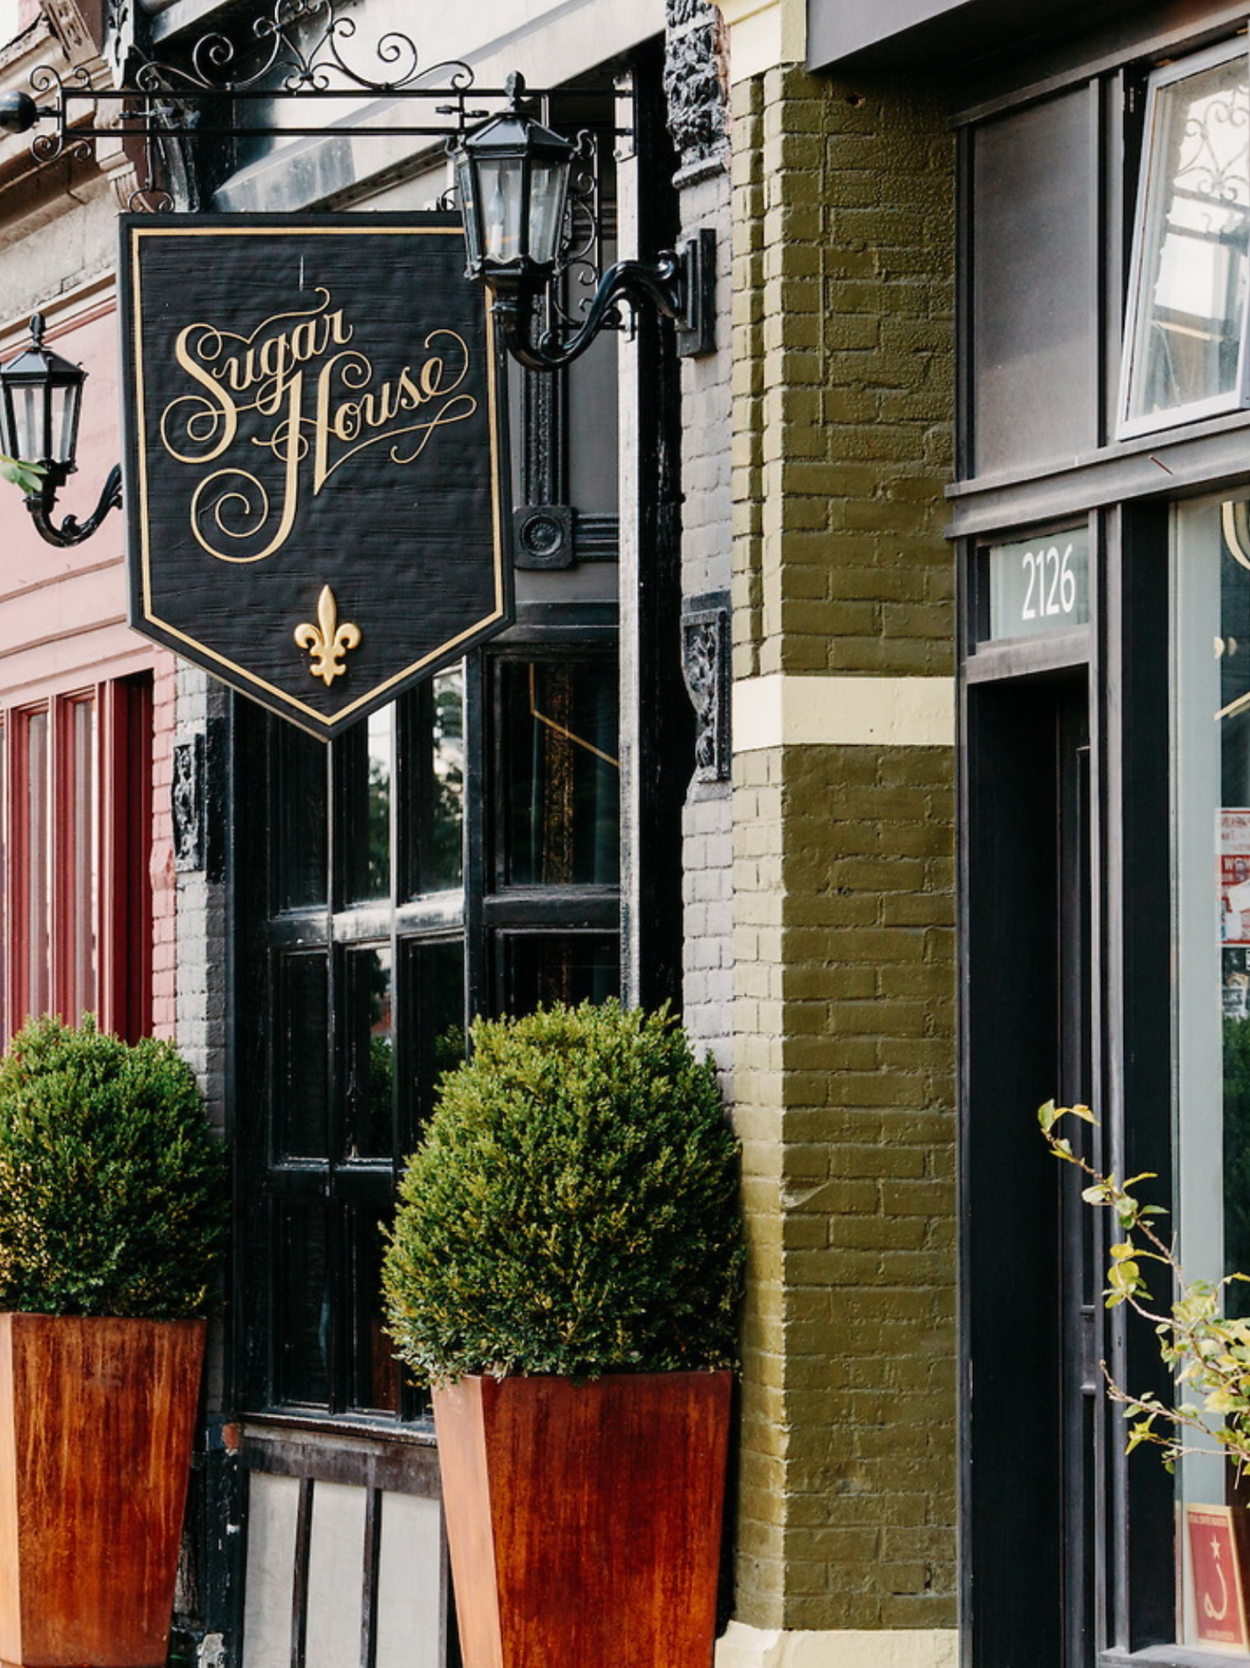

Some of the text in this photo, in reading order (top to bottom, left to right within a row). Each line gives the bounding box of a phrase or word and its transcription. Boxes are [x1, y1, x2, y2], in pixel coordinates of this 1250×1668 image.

[160, 286, 354, 464] Sugar
[190, 328, 478, 564] House
[1021, 543, 1076, 620] 2126
